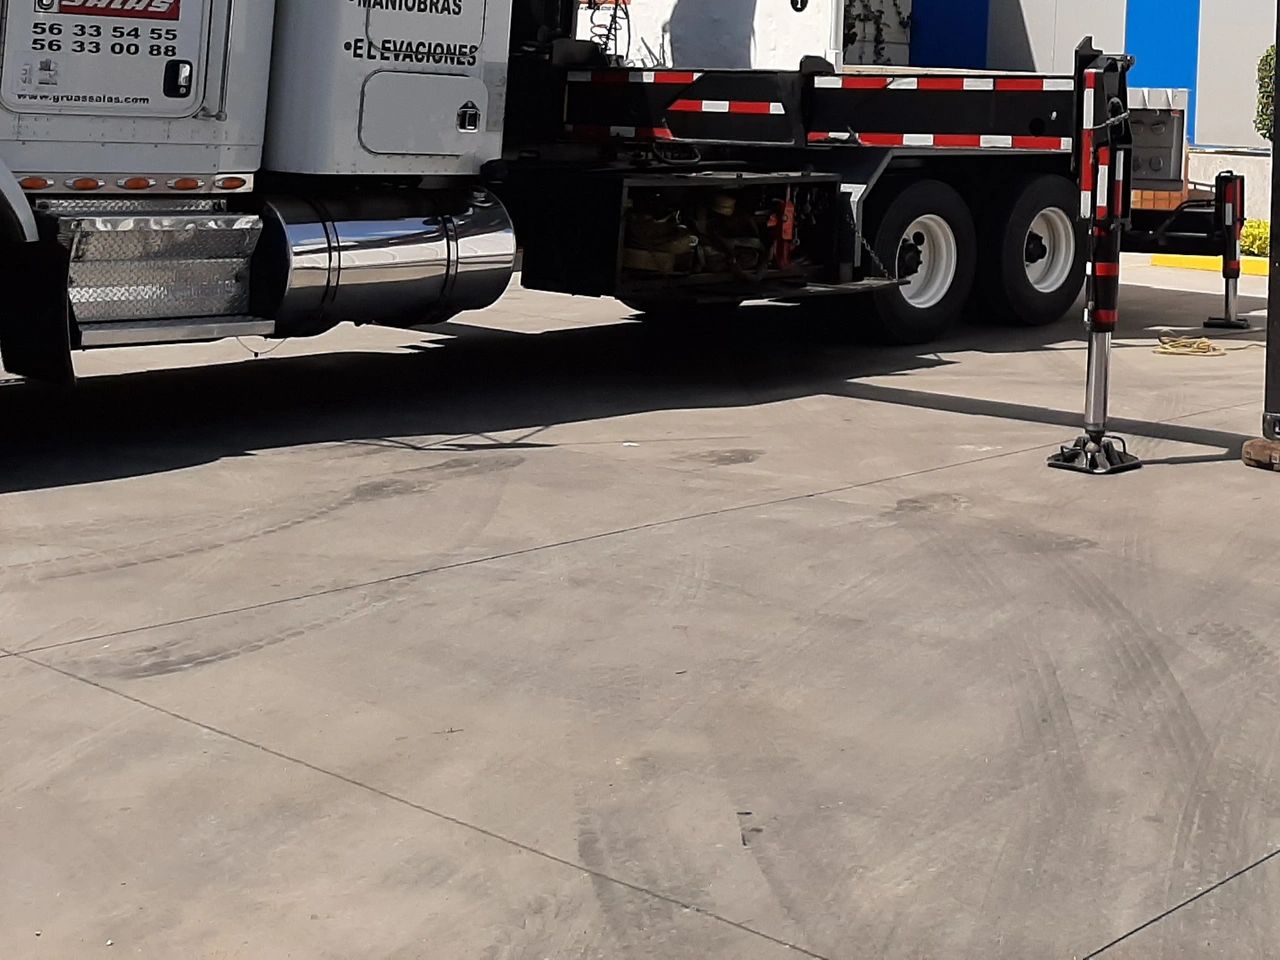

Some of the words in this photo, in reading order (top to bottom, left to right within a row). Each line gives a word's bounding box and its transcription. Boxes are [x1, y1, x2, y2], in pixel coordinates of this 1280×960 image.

[31, 22, 63, 36] 56
[72, 24, 102, 38] 33
[111, 26, 141, 40] 54
[149, 28, 178, 41] 55
[31, 38, 62, 52] 56
[71, 40, 101, 54] 33
[110, 42, 140, 56] 00
[148, 44, 177, 57] 88
[352, 38, 479, 67] ELEVACIONES
[17, 93, 150, 104] www.gruassalas.com
